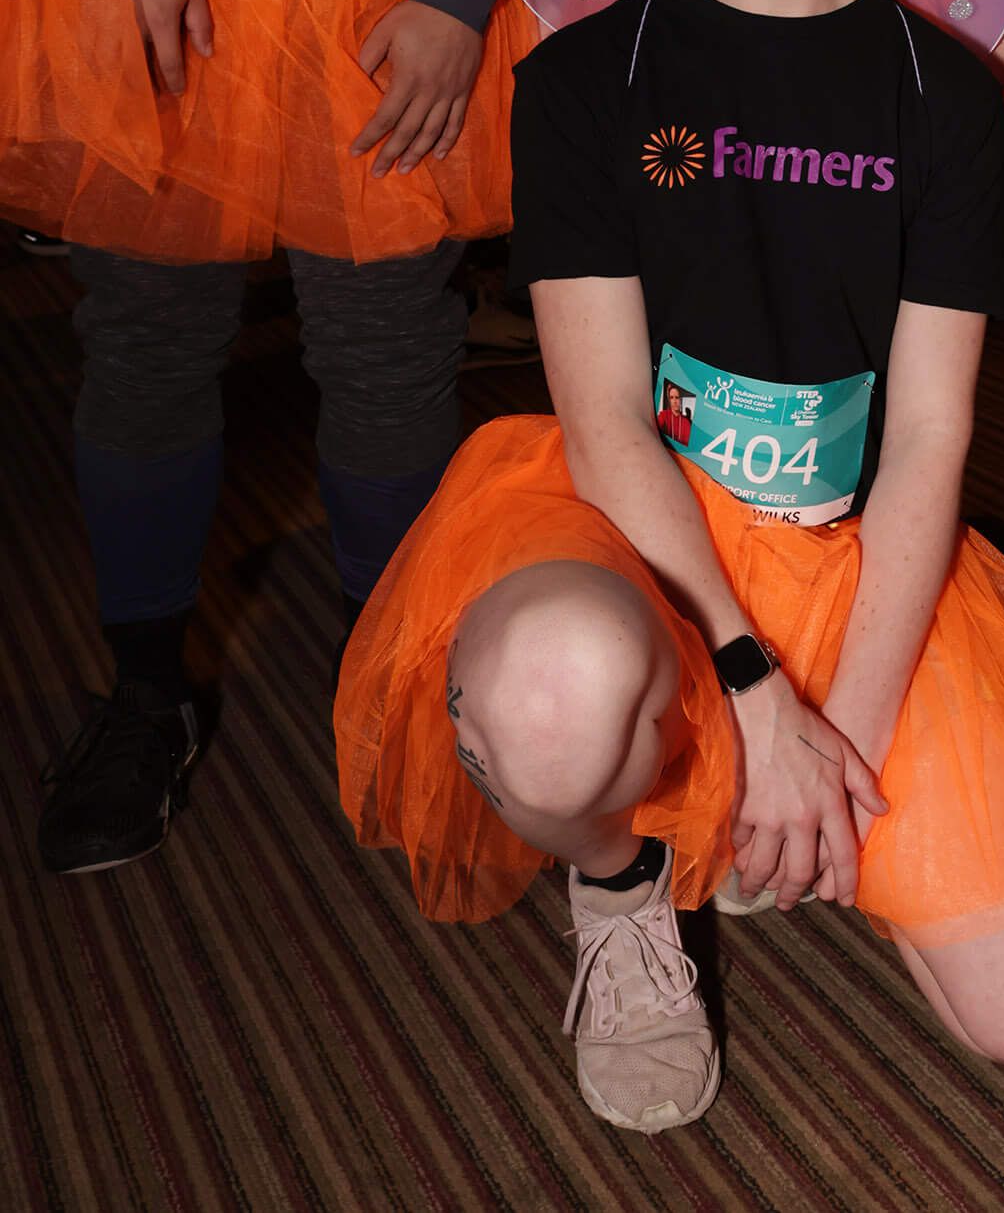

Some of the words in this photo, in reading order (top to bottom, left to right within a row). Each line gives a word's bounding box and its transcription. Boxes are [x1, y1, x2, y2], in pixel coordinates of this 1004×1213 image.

[712, 126, 896, 192] Farmers
[701, 428, 820, 486] 404
[722, 484, 757, 499] PORT
[758, 492, 798, 503] OFFICE
